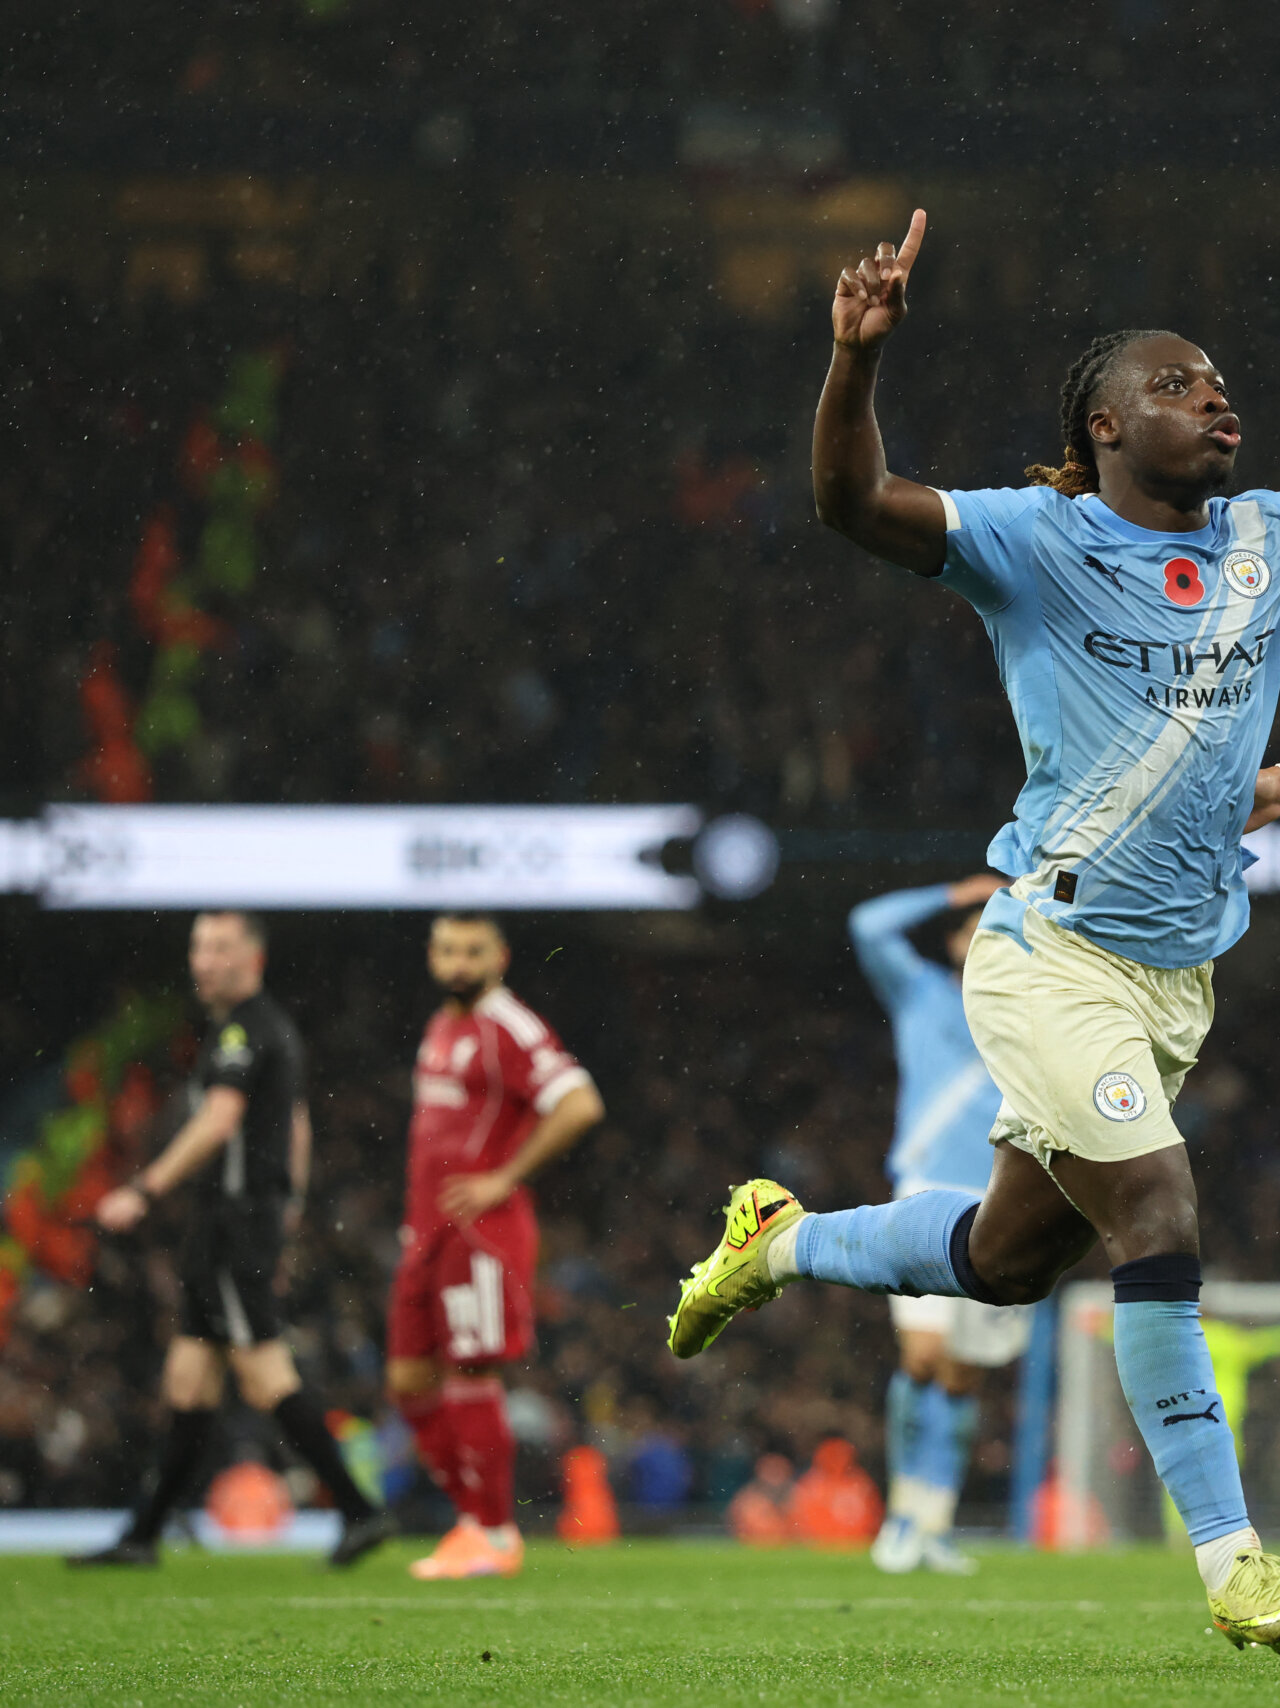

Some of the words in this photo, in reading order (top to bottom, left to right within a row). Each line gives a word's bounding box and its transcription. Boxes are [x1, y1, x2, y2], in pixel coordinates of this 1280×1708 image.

[1225, 552, 1260, 572] MANCHESTER
[1145, 680, 1252, 709] AIRWAYS
[1097, 1075, 1134, 1097] MANCHESTER
